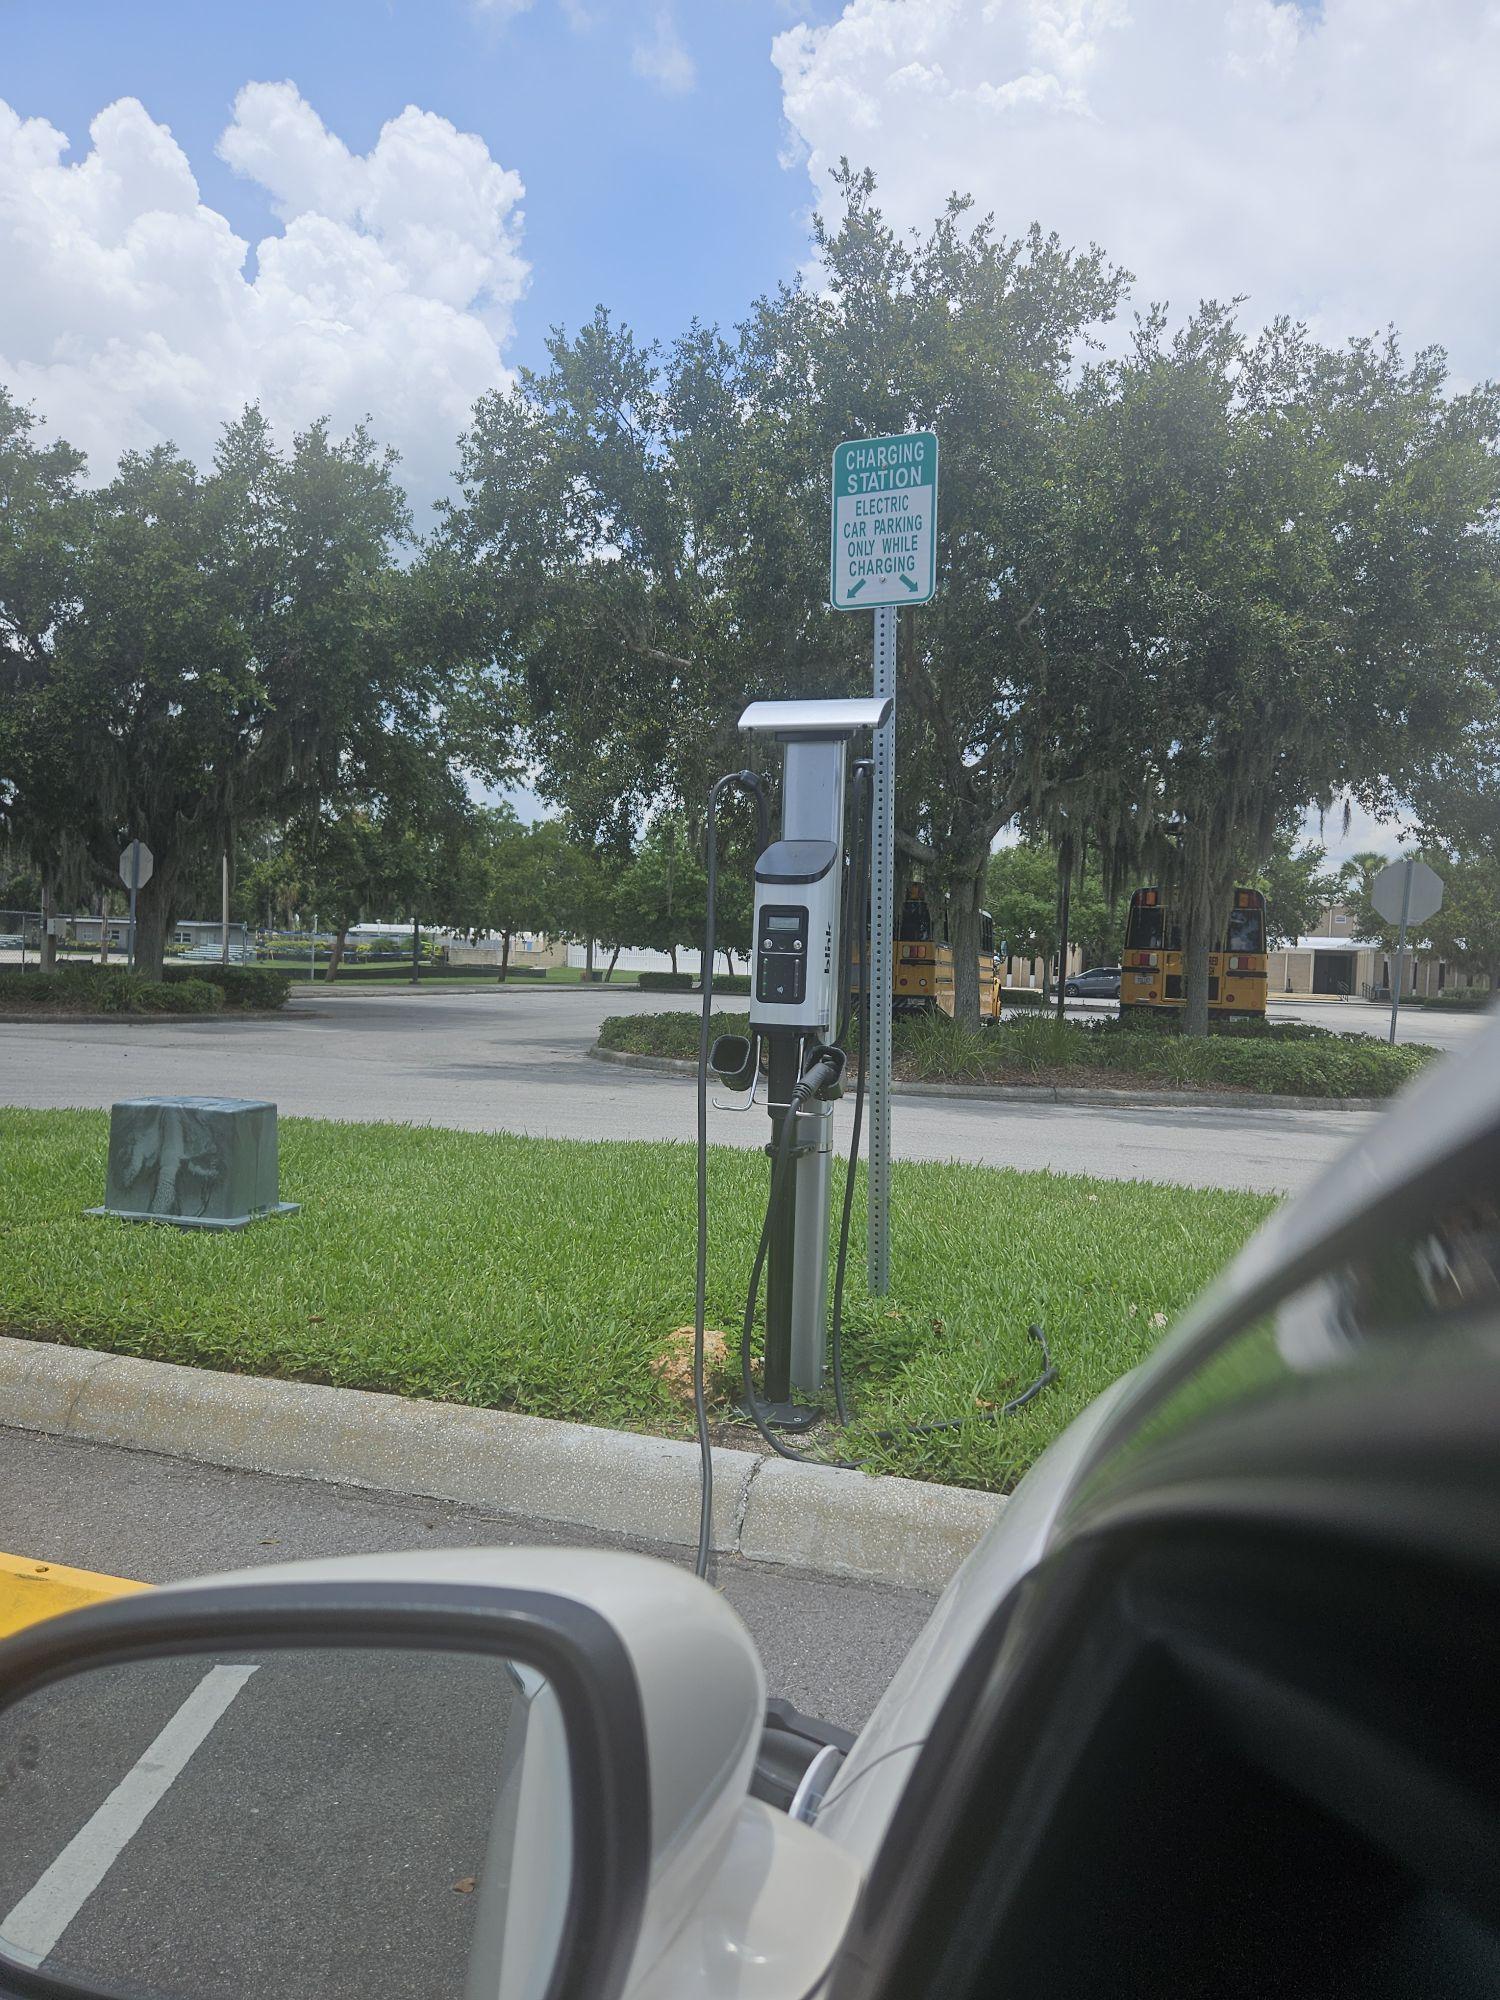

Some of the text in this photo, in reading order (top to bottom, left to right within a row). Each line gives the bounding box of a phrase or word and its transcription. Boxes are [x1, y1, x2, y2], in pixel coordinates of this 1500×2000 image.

[846, 441, 924, 471] CHARGING
[847, 466, 922, 494] STATION
[855, 495, 909, 517] ELECTRIC
[843, 514, 923, 539] CAR PARKING
[847, 535, 918, 558] ONLY WHILE
[849, 555, 915, 577] CHARGING
